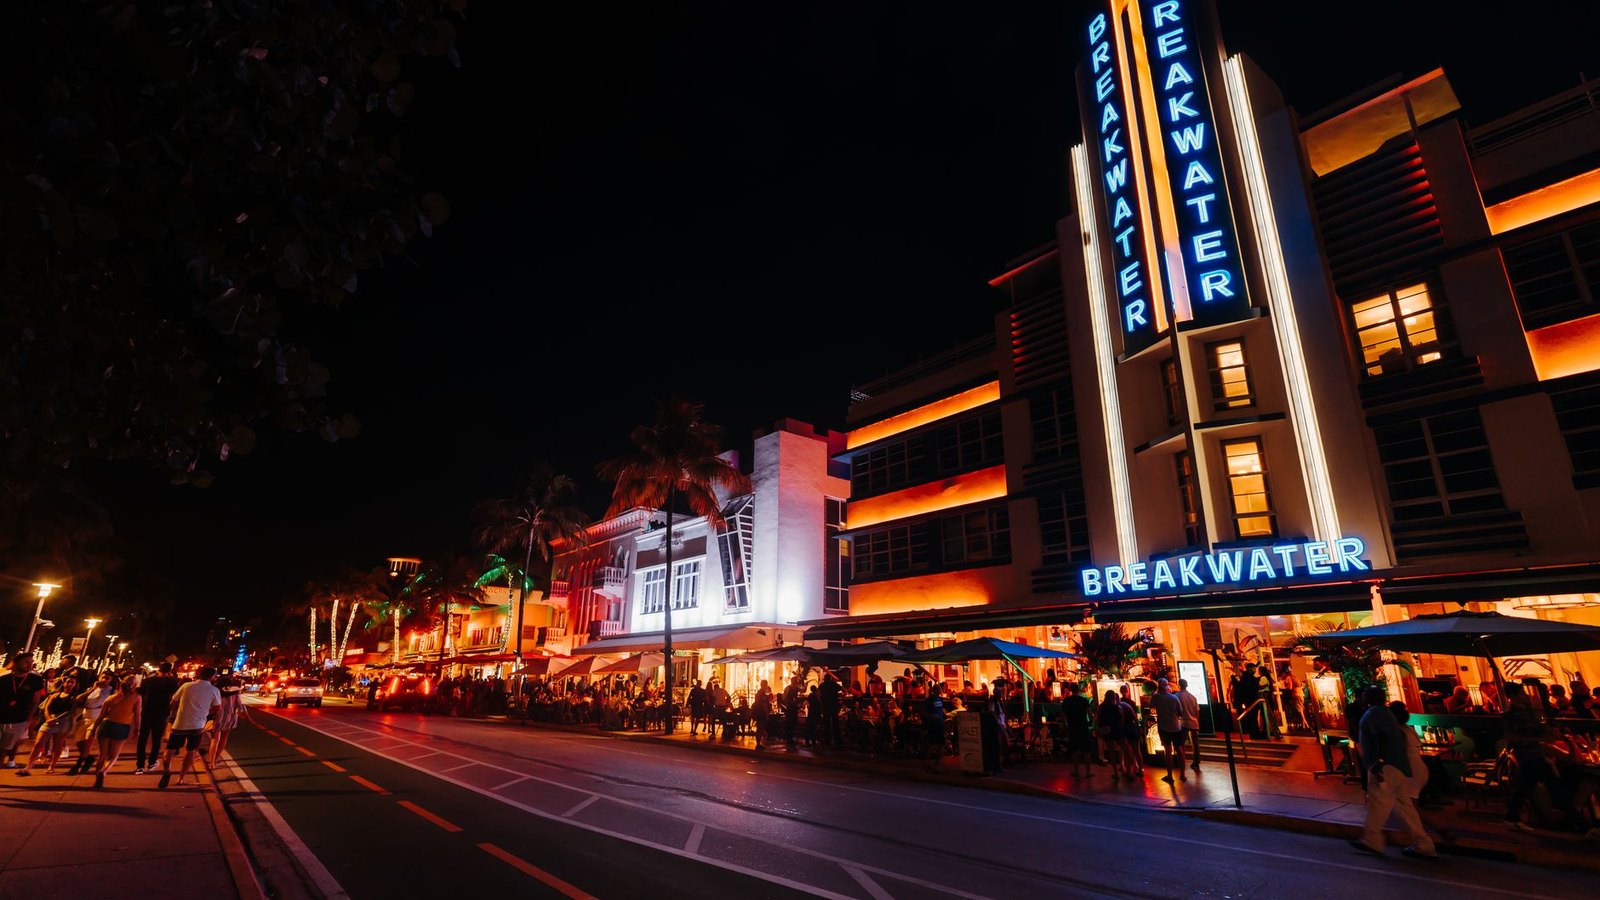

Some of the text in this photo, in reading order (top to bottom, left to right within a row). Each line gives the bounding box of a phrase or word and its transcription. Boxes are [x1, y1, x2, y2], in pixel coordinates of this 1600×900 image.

[1088, 13, 1147, 332] BREAKWATER
[1081, 537, 1368, 596] BREAKWATER
[960, 726, 978, 737] VALET
